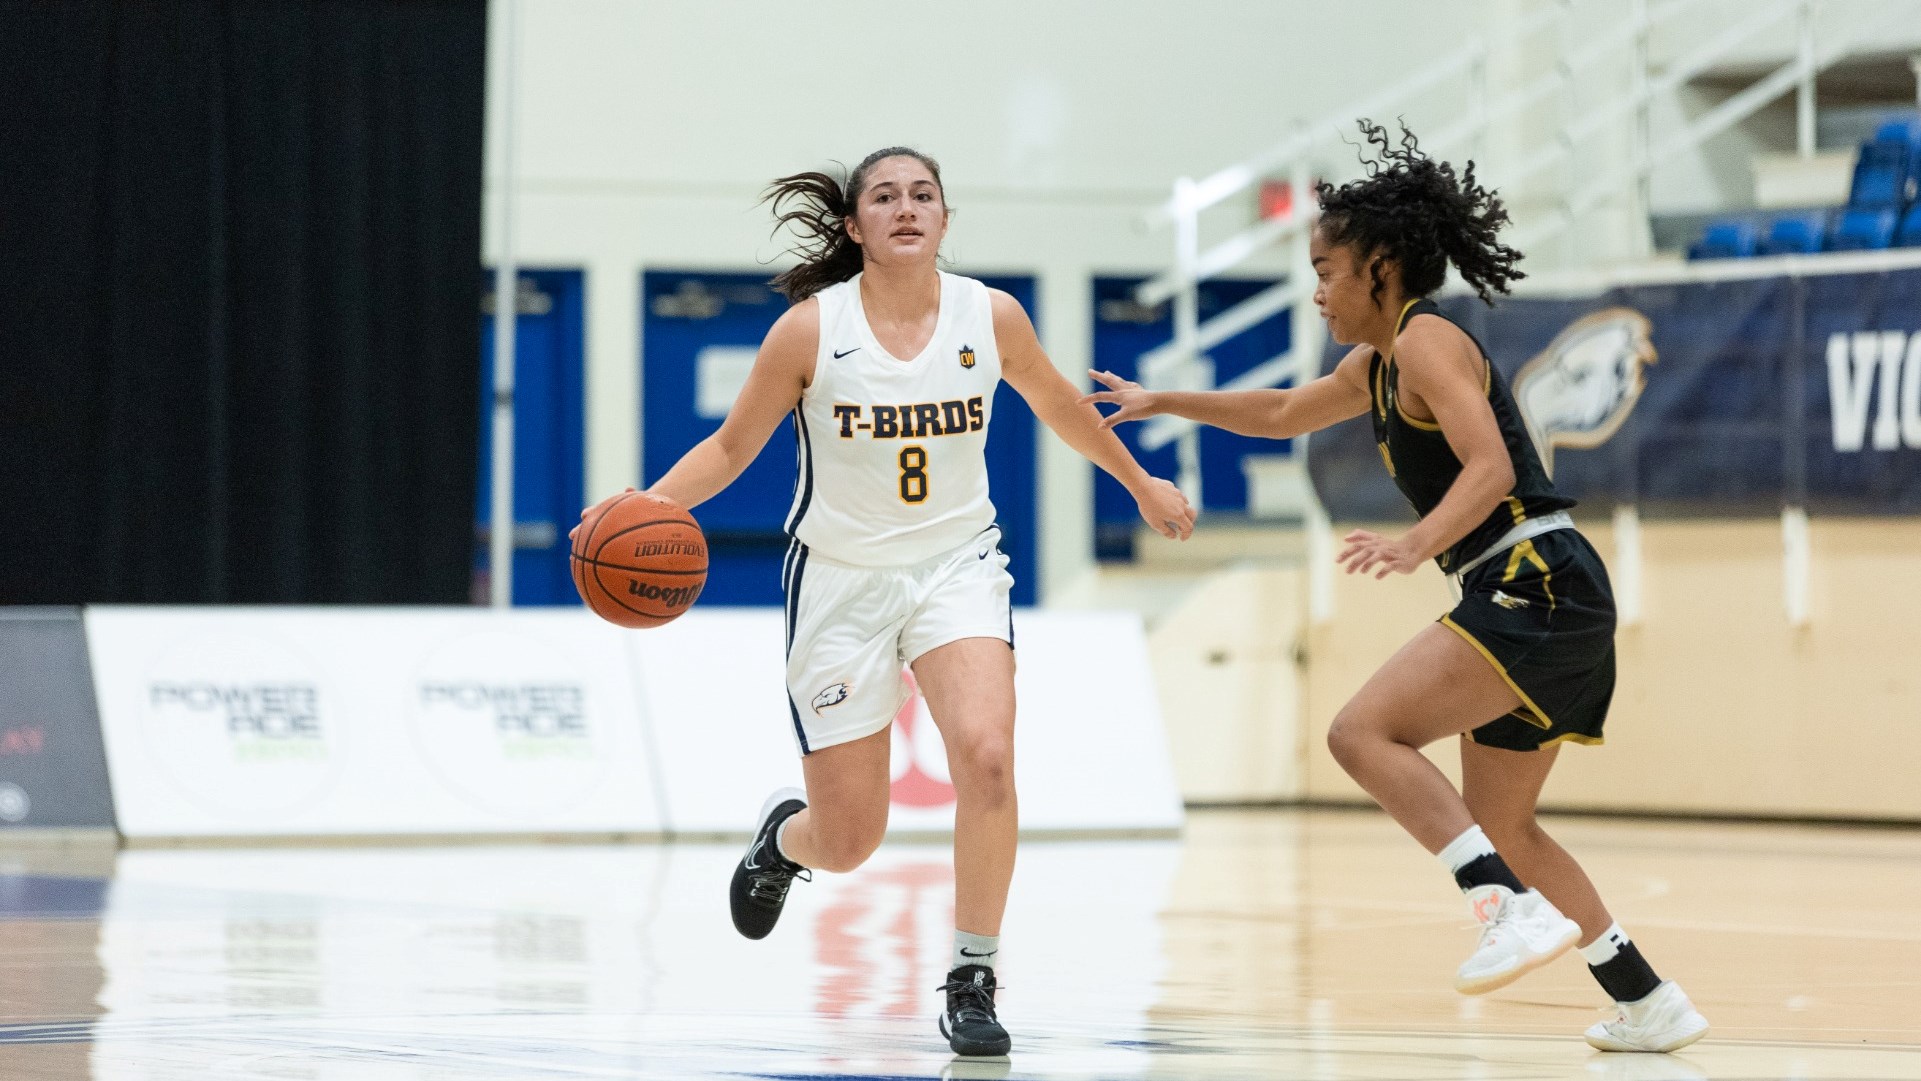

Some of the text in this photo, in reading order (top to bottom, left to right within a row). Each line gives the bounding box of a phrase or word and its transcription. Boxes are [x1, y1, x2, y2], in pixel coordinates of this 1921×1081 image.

[960, 352, 974, 366] CW
[832, 395, 984, 440] T-BIRDS
[898, 444, 929, 506] 8
[149, 680, 318, 713] POWER
[419, 679, 585, 713] POWER
